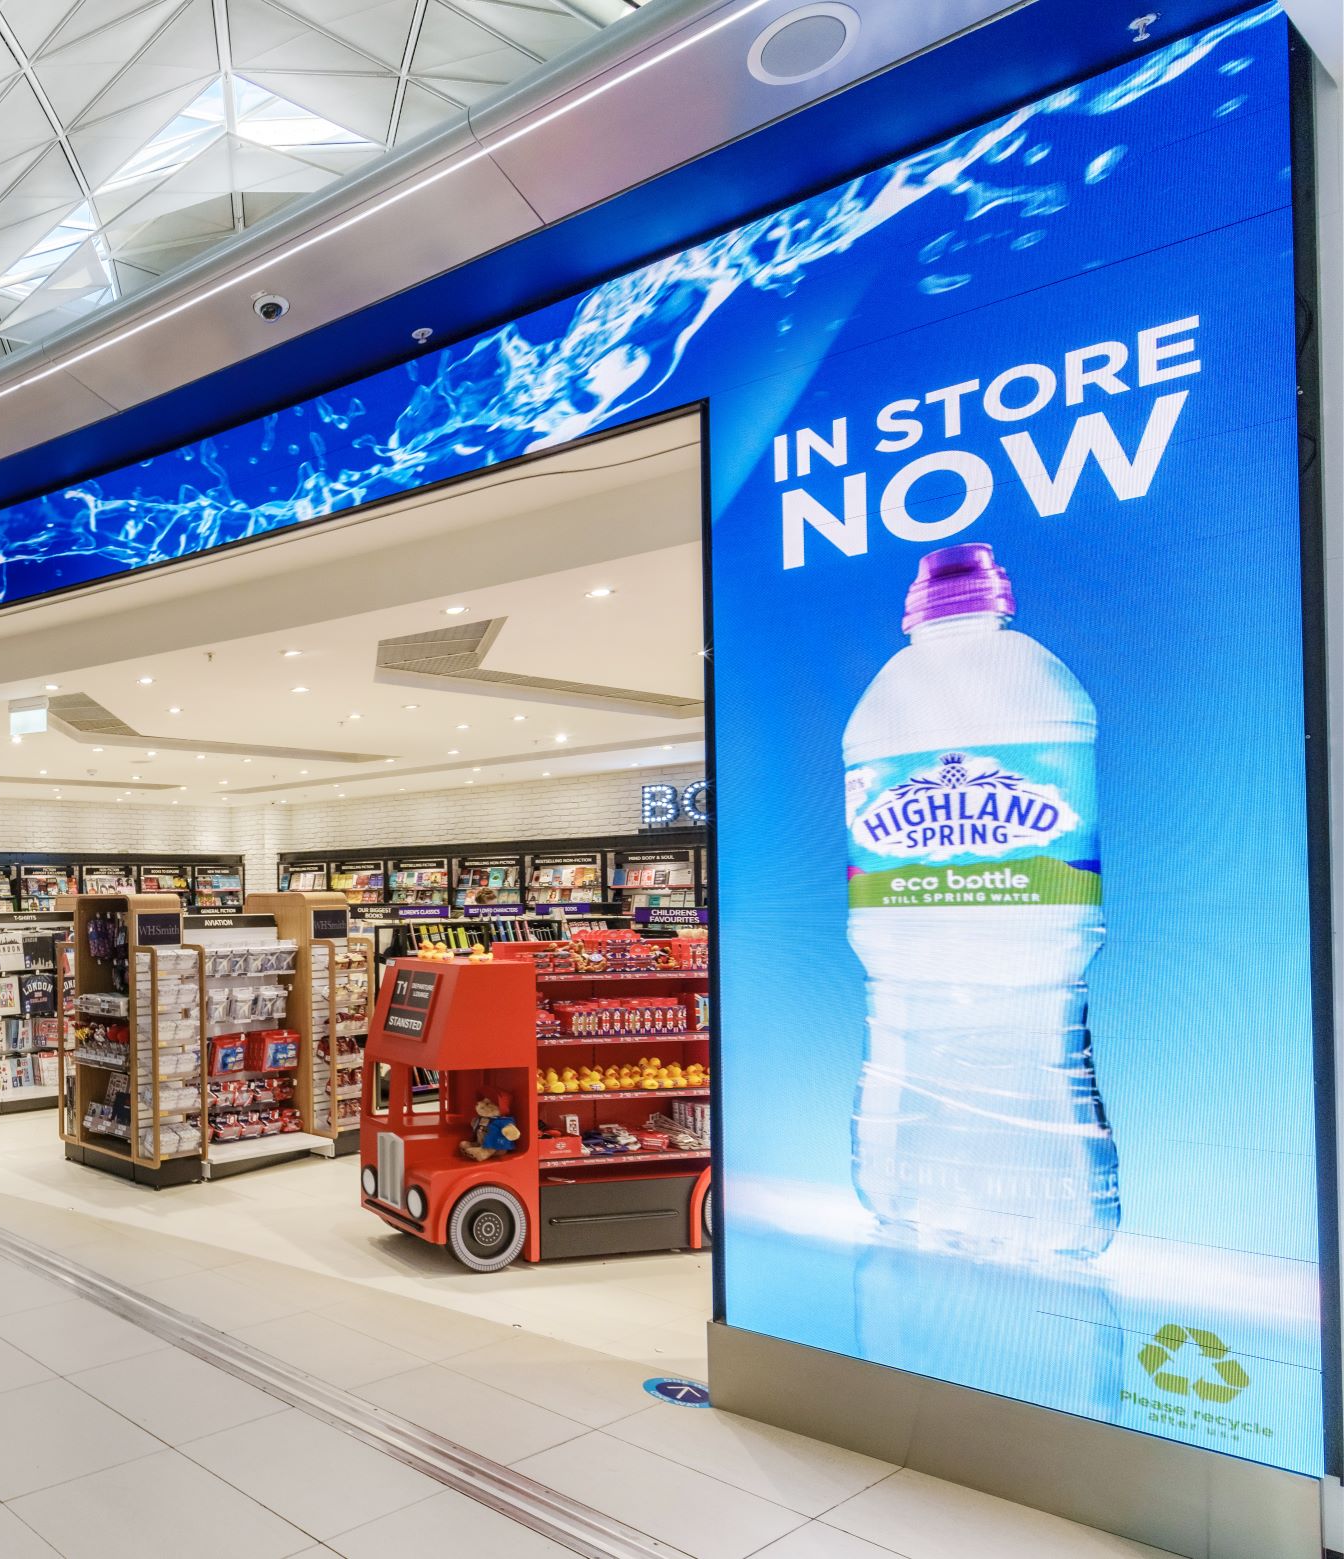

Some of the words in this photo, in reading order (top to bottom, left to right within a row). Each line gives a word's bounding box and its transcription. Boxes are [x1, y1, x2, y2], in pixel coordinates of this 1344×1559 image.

[774, 416, 847, 483] IN
[874, 314, 1202, 453] STORE
[781, 389, 1190, 571] NOW
[863, 792, 1060, 843] HIGHLAND
[906, 823, 1009, 849] SPRING
[890, 876, 939, 892] eco
[947, 868, 1029, 890] bottle
[883, 895, 918, 905] STILL
[923, 892, 986, 903] SPRING
[990, 892, 1041, 903] WATER
[649, 916, 700, 924] FAVOURITES
[651, 909, 698, 917] CHILDRENS
[139, 924, 181, 936] WHSmith
[22, 981, 53, 996] LONDON
[396, 980, 408, 995] T1
[388, 1015, 423, 1031] STANSTED
[1119, 1389, 1186, 1416] Please
[1193, 1408, 1274, 1438] recycle
[1149, 1411, 1197, 1431] after
